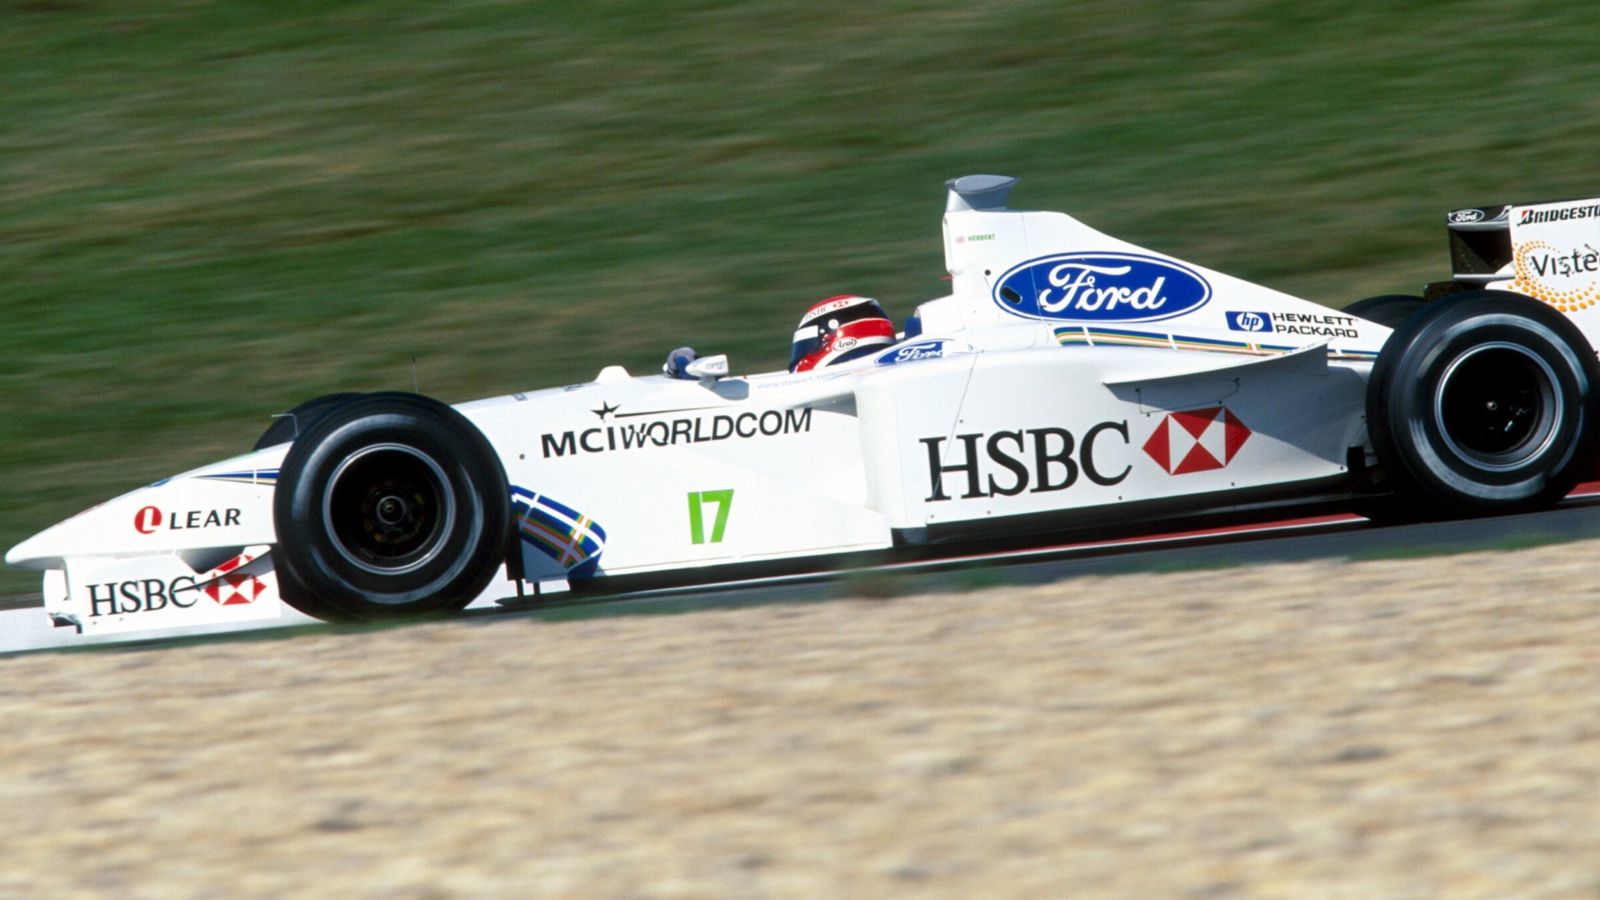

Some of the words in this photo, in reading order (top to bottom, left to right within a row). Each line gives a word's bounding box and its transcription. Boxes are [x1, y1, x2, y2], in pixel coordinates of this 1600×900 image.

[1455, 212, 1479, 222] Ford
[1039, 263, 1167, 313] Ford
[1240, 311, 1260, 332] hp
[1272, 312, 1355, 326] HEWLETT
[1275, 324, 1359, 338] PACKARD
[919, 419, 1133, 502] HSBC
[169, 508, 241, 530] LEAR
[687, 489, 735, 544] 17
[86, 576, 198, 617] HSBC
